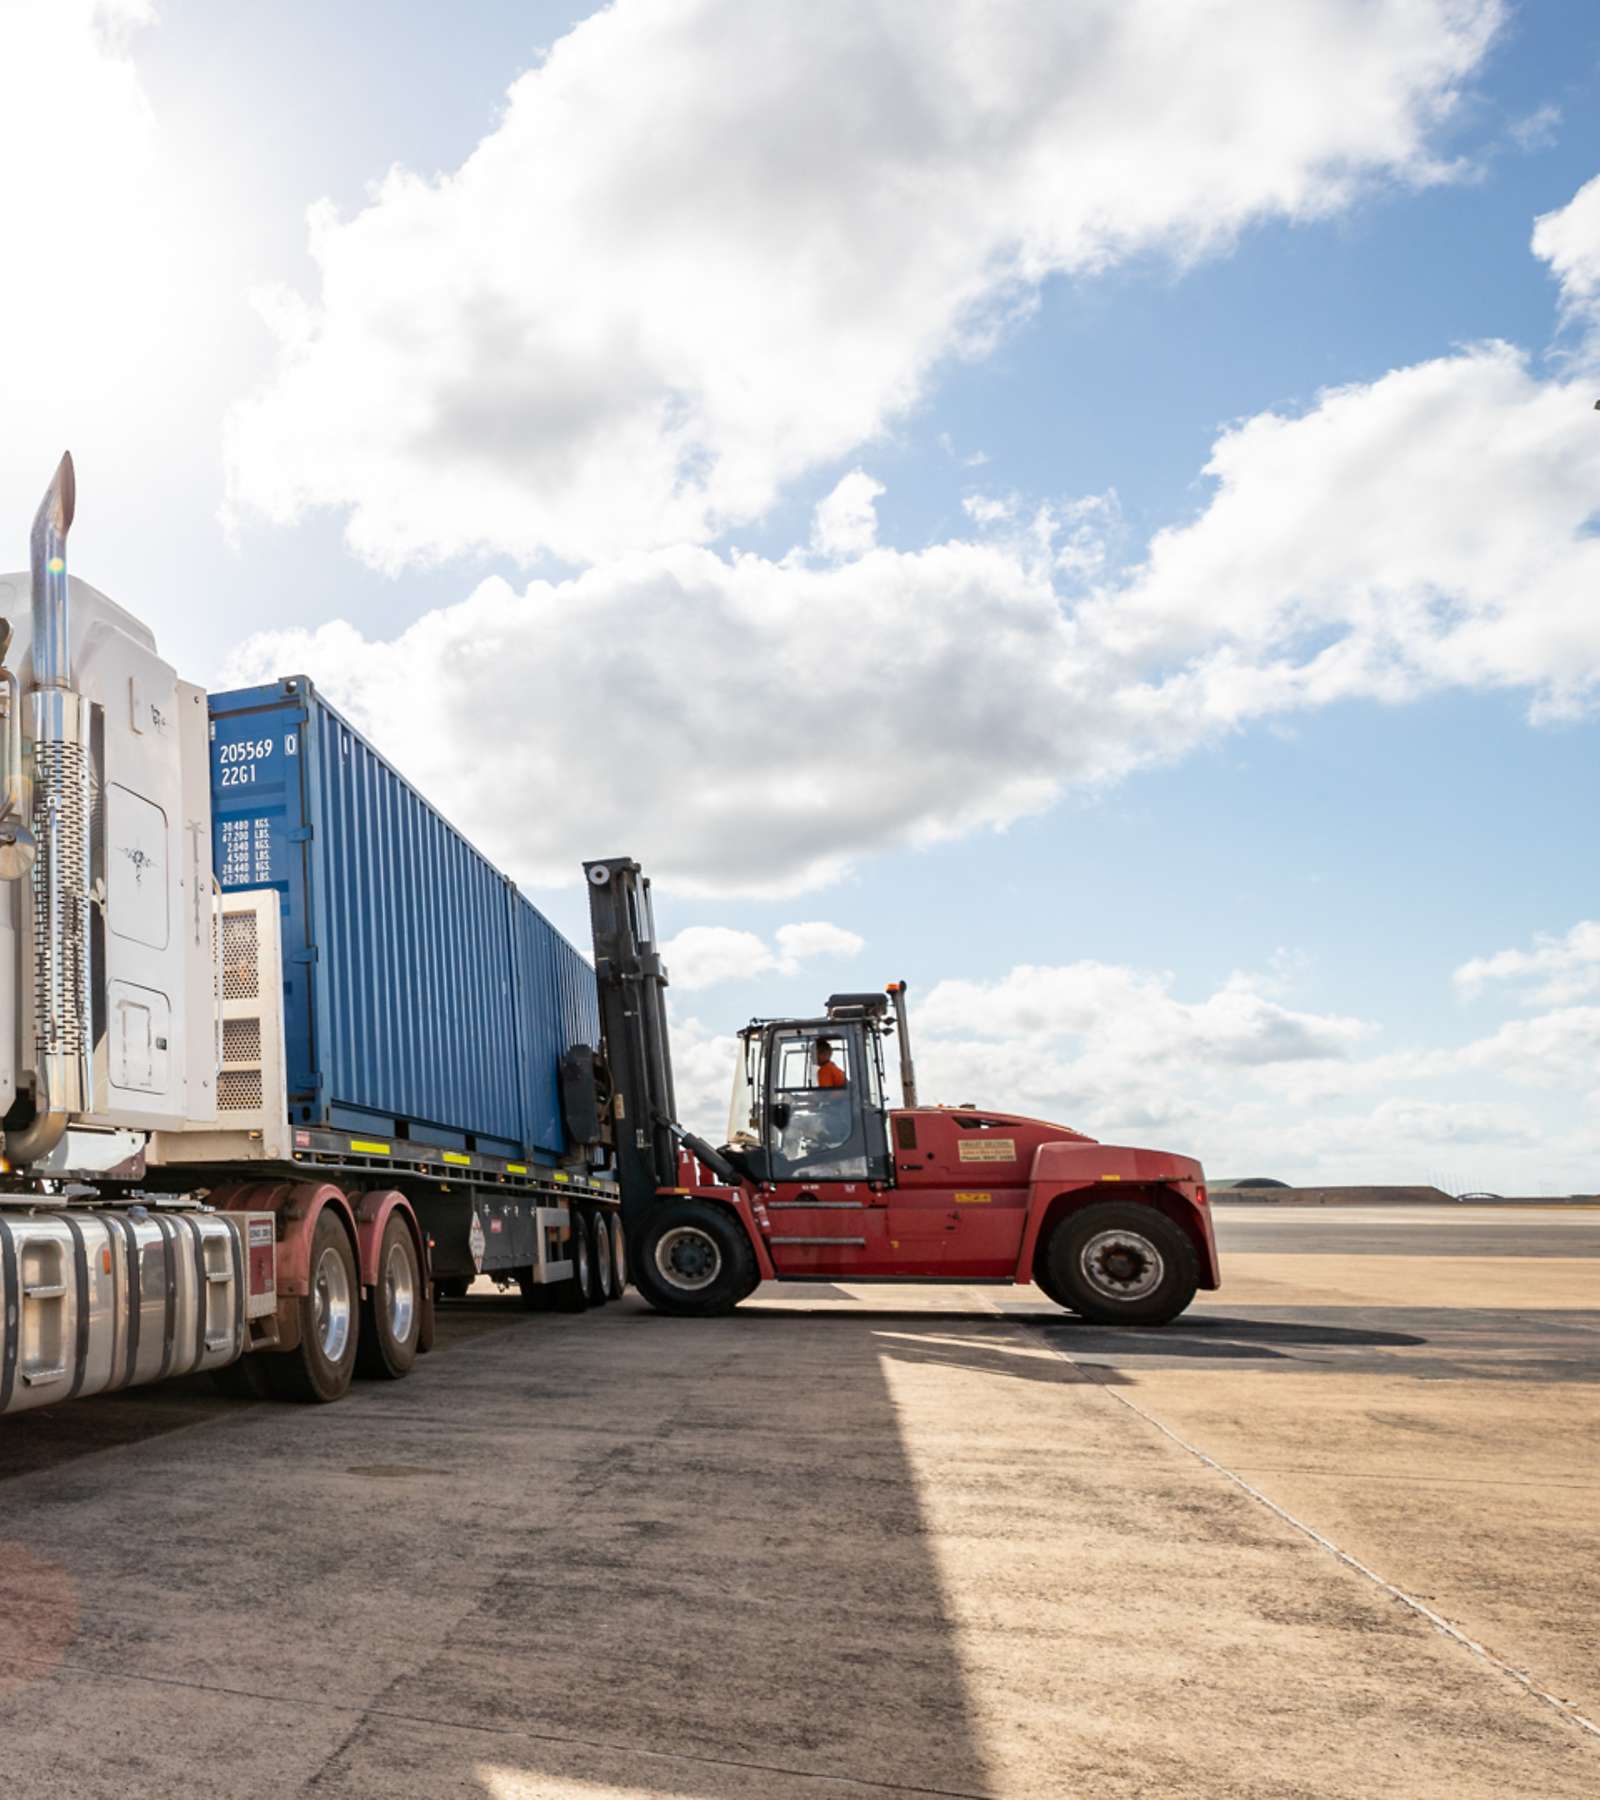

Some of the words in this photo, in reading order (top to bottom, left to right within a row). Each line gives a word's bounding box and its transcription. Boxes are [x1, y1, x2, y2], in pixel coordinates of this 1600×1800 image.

[220, 738, 273, 764] 205569
[285, 734, 297, 755] 0
[222, 764, 255, 786] 22G1
